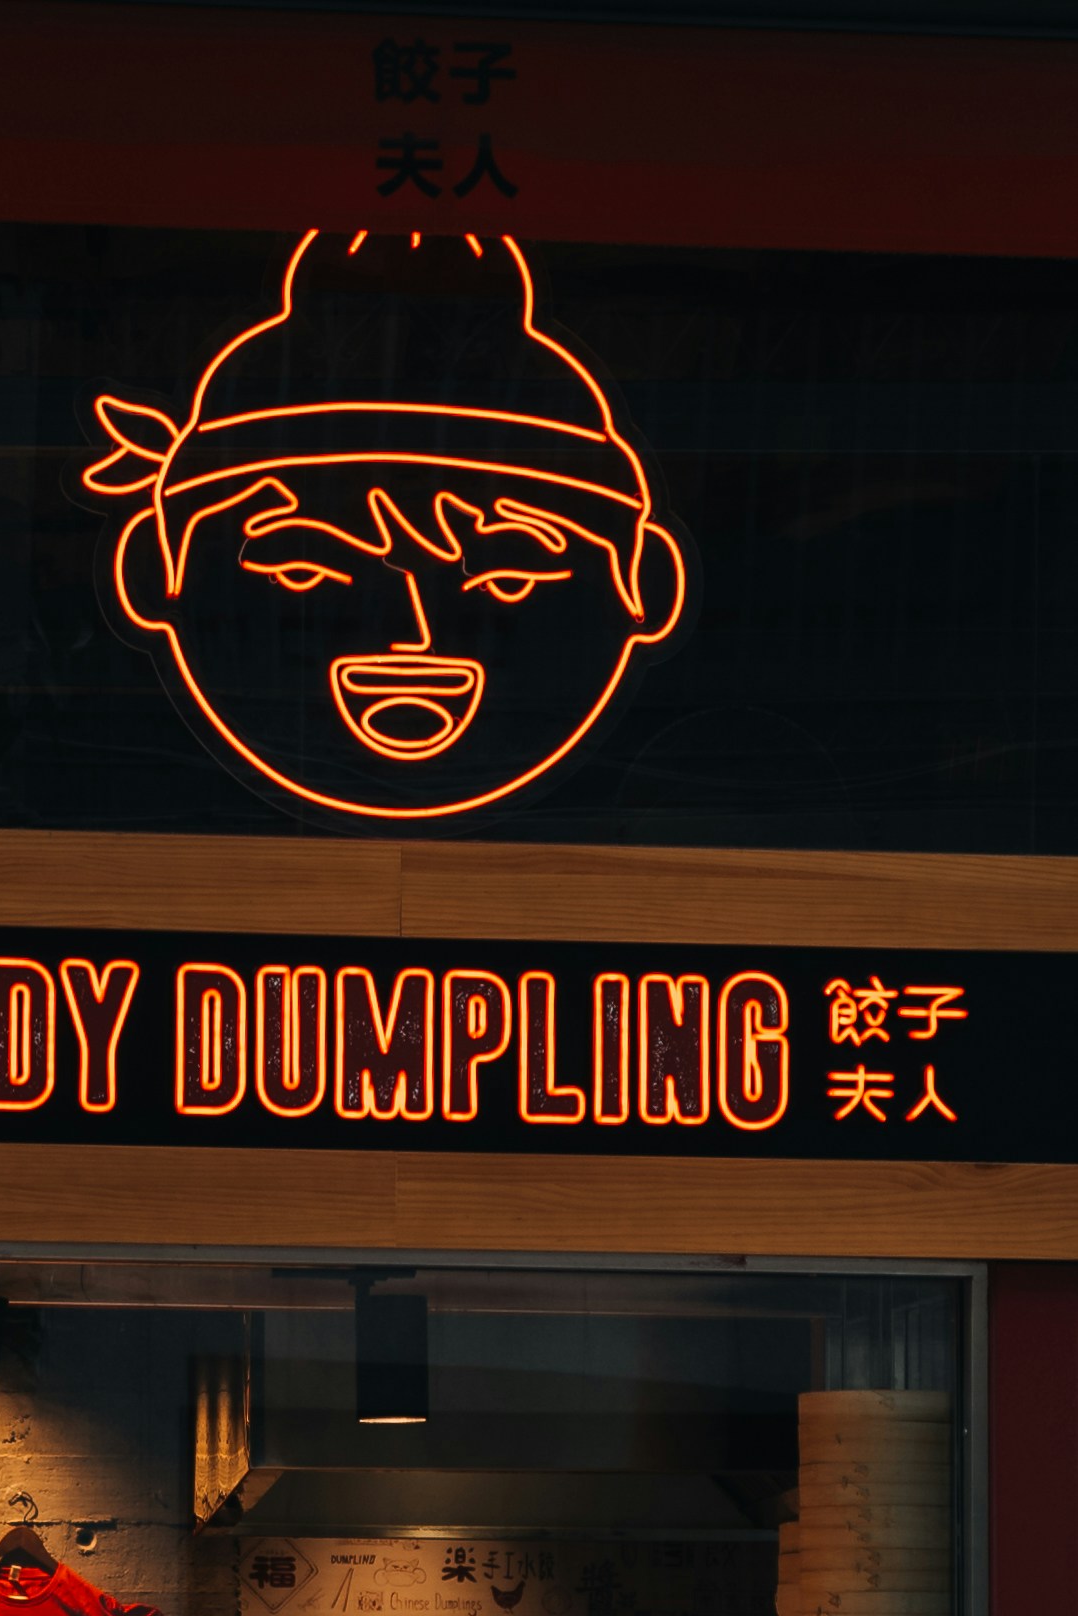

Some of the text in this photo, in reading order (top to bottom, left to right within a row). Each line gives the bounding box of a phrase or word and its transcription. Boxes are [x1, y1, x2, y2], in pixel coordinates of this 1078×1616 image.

[372, 37, 517, 105] 餃子
[376, 132, 519, 198] 夫人
[824, 975, 969, 1047] 餃子
[173, 962, 790, 1131] DUMPLING
[826, 1063, 958, 1122] 夫人
[249, 1556, 296, 1588] 福
[330, 1554, 376, 1565] DUMPLING
[390, 1592, 430, 1611] Chinese
[435, 1592, 483, 1616] Dumplings
